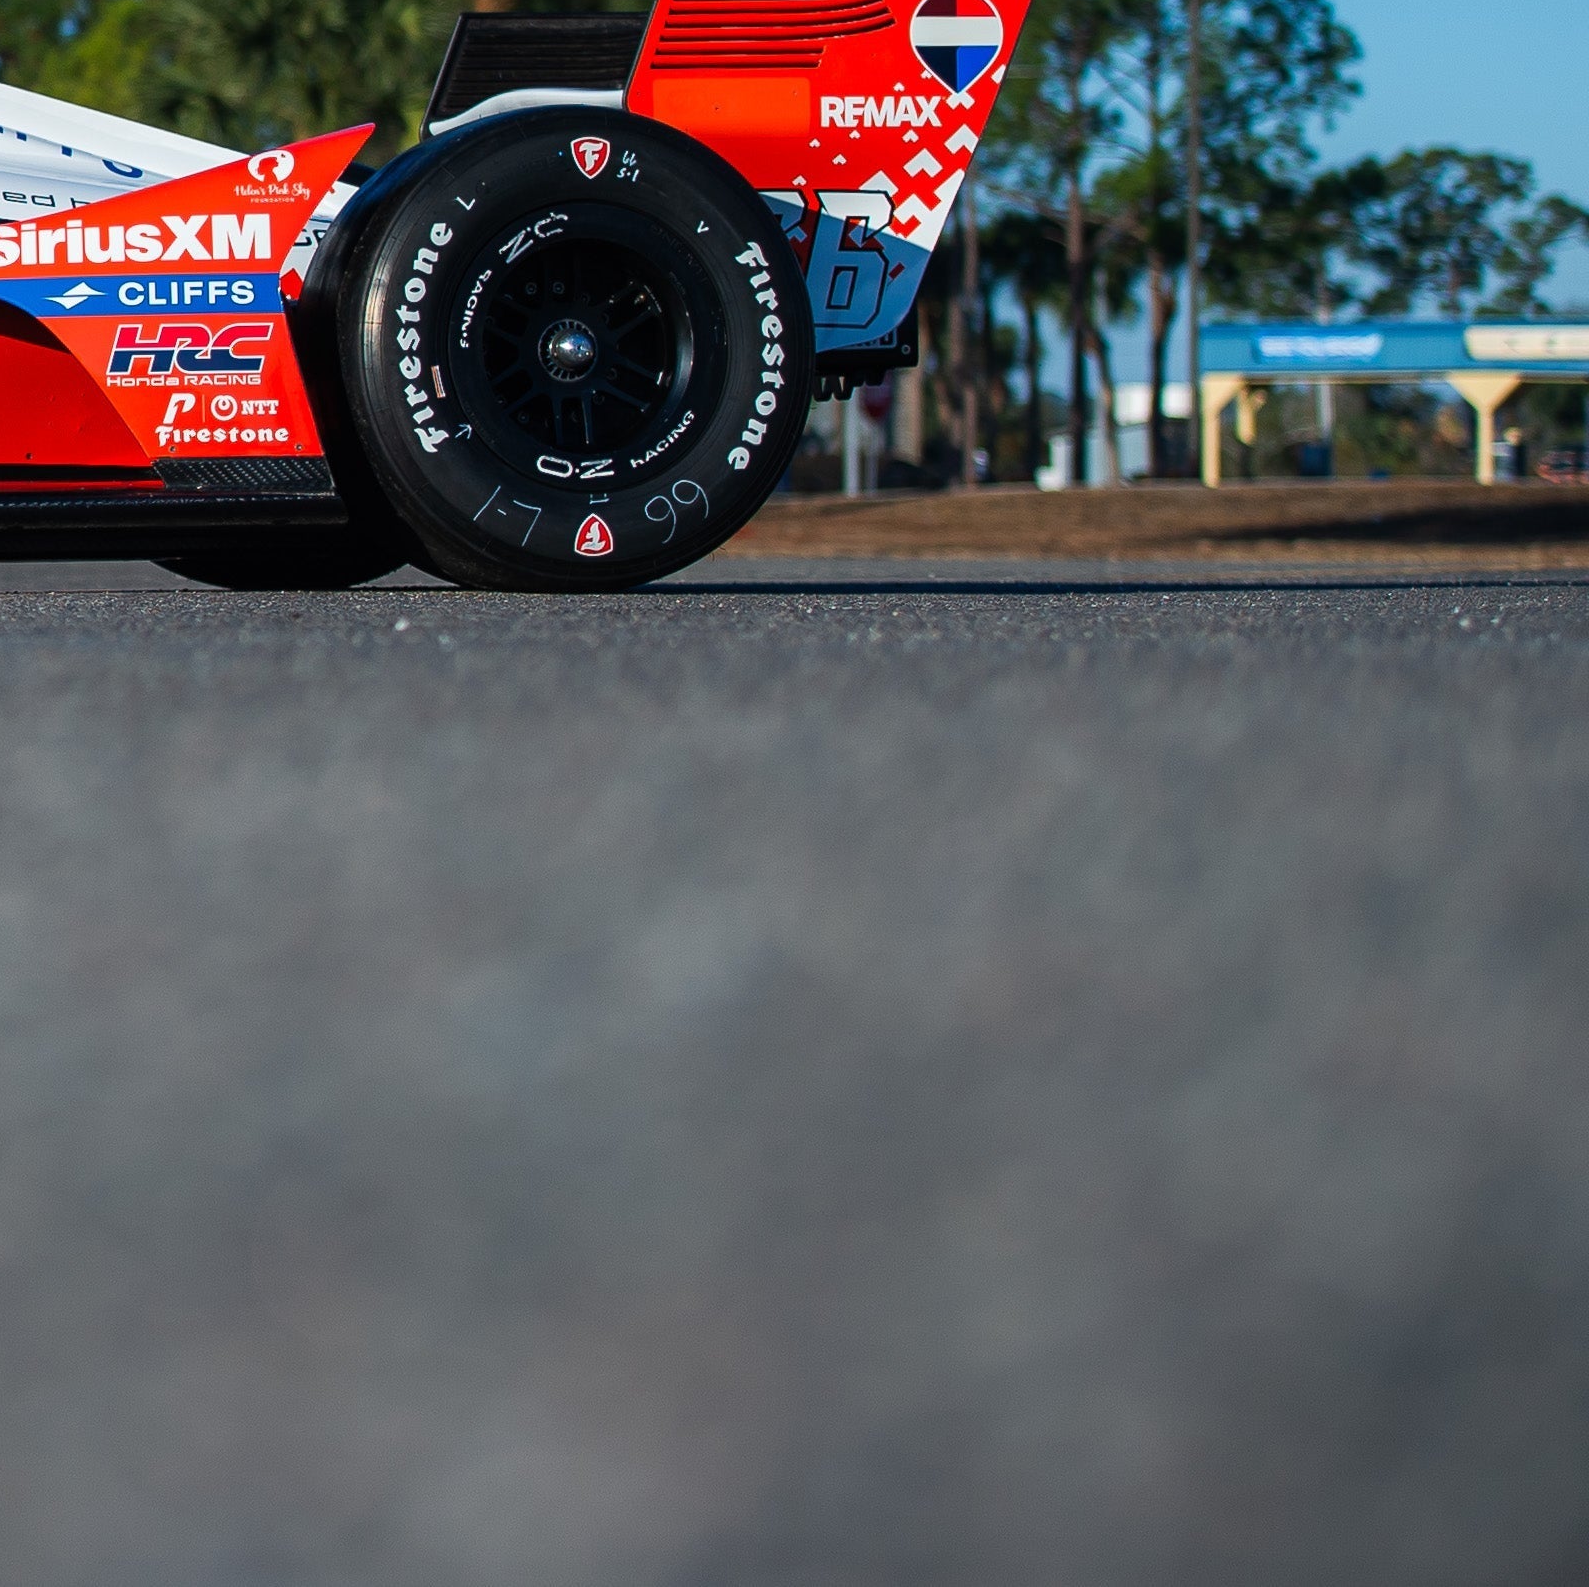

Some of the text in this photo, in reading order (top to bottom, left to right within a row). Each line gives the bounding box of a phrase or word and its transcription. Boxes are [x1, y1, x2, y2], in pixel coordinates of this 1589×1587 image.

[820, 96, 942, 127] REMAX
[118, 280, 255, 306] CLIFFS
[106, 323, 273, 375] HRC
[396, 222, 453, 453] Firestone
[727, 242, 785, 470] Firestone
[106, 374, 261, 387] Honda RACING
[241, 400, 279, 415] NTT
[155, 425, 289, 446] Firestone
[645, 480, 709, 544] 66
